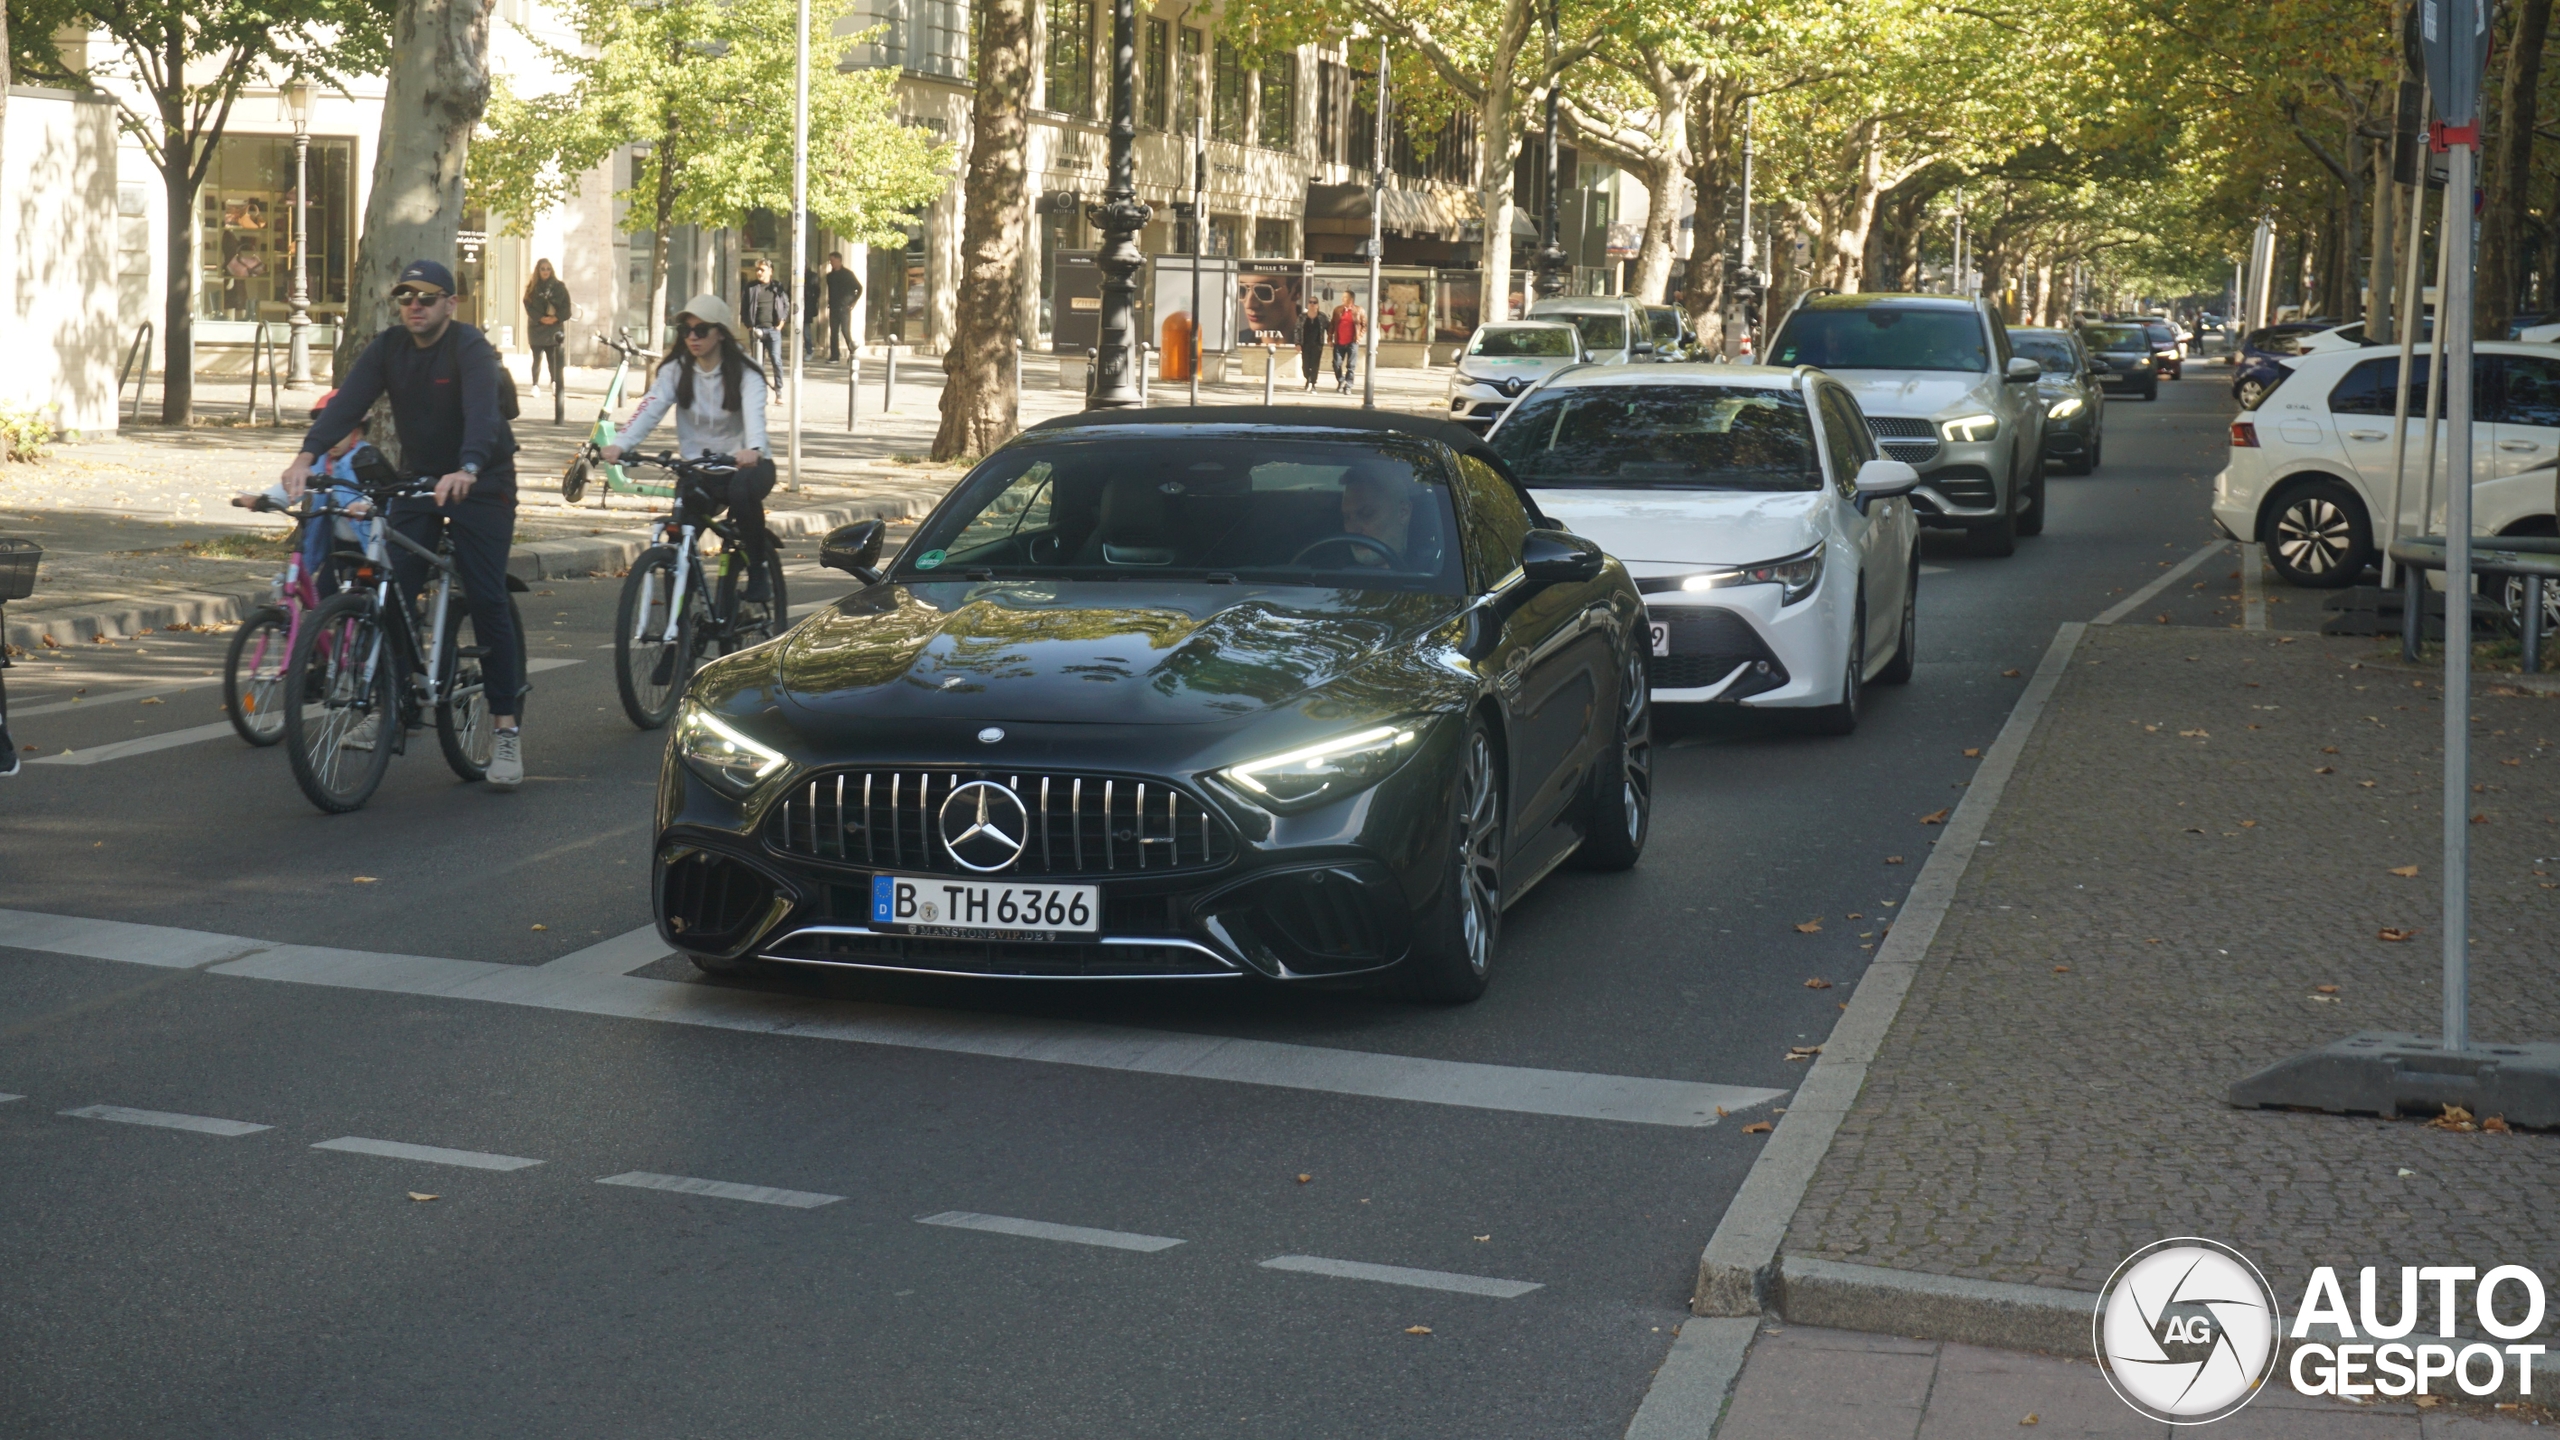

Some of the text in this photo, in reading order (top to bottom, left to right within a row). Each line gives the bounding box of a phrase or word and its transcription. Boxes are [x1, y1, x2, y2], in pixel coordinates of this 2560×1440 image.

[1254, 329, 1284, 339] DITA
[879, 882, 1090, 926] D B TH 6366
[919, 925, 1044, 941] MANSTONEVIP.DE
